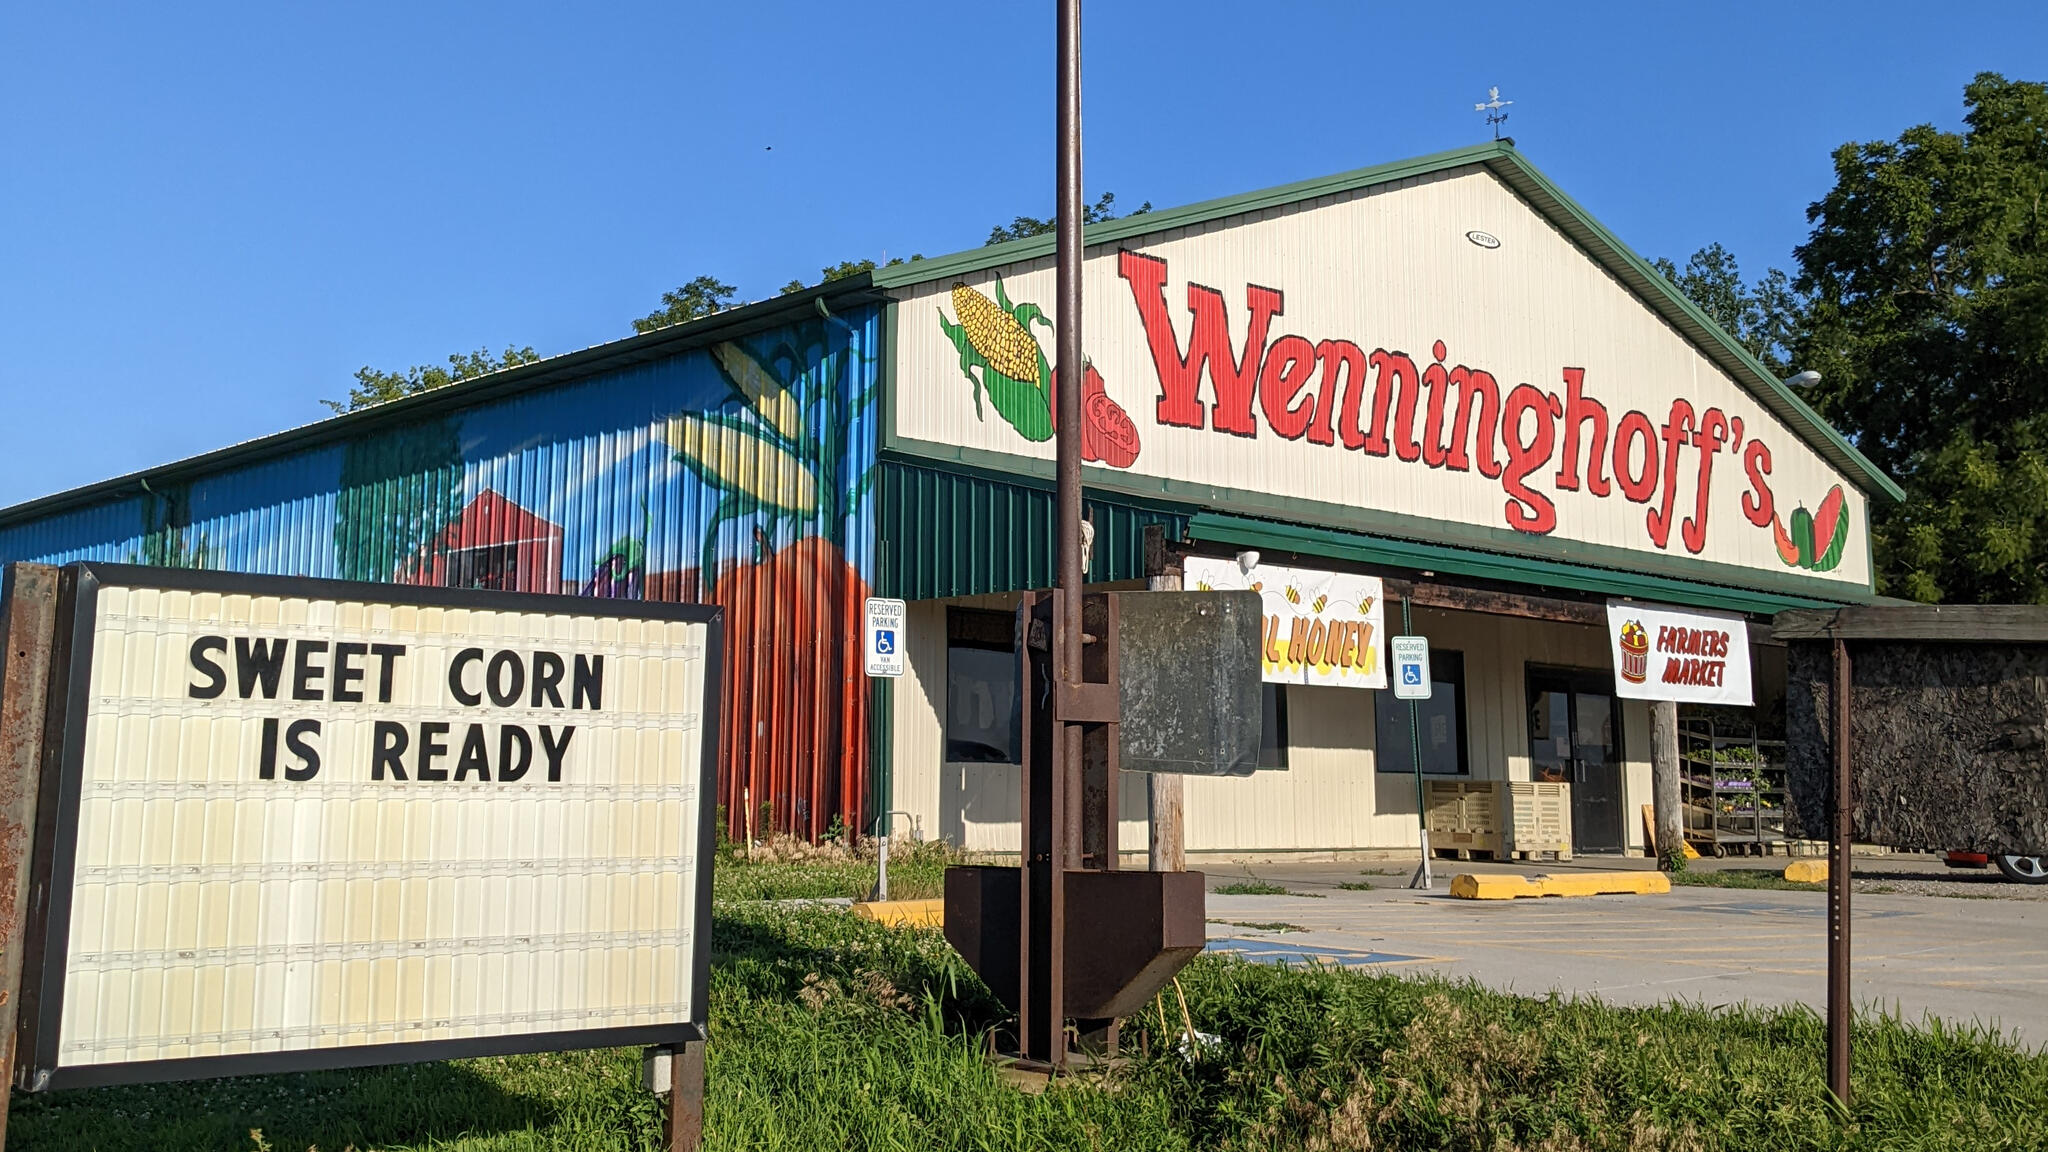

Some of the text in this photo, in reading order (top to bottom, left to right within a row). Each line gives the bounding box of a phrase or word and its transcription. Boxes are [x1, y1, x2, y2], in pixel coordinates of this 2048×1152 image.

[1119, 248, 1774, 554] Wenninghoff's
[869, 603, 902, 616] RESERVED
[872, 616, 899, 629] PARKING
[1288, 615, 1374, 669] HONEY
[1395, 643, 1425, 652] RESERVED
[1398, 653, 1423, 662] PARKING
[1656, 625, 1730, 658] FARMERS
[188, 635, 604, 711] SWEET CORN
[870, 663, 901, 672] ACCESSIBLE
[1661, 656, 1726, 688] MARKET
[259, 717, 577, 783] IS READY
